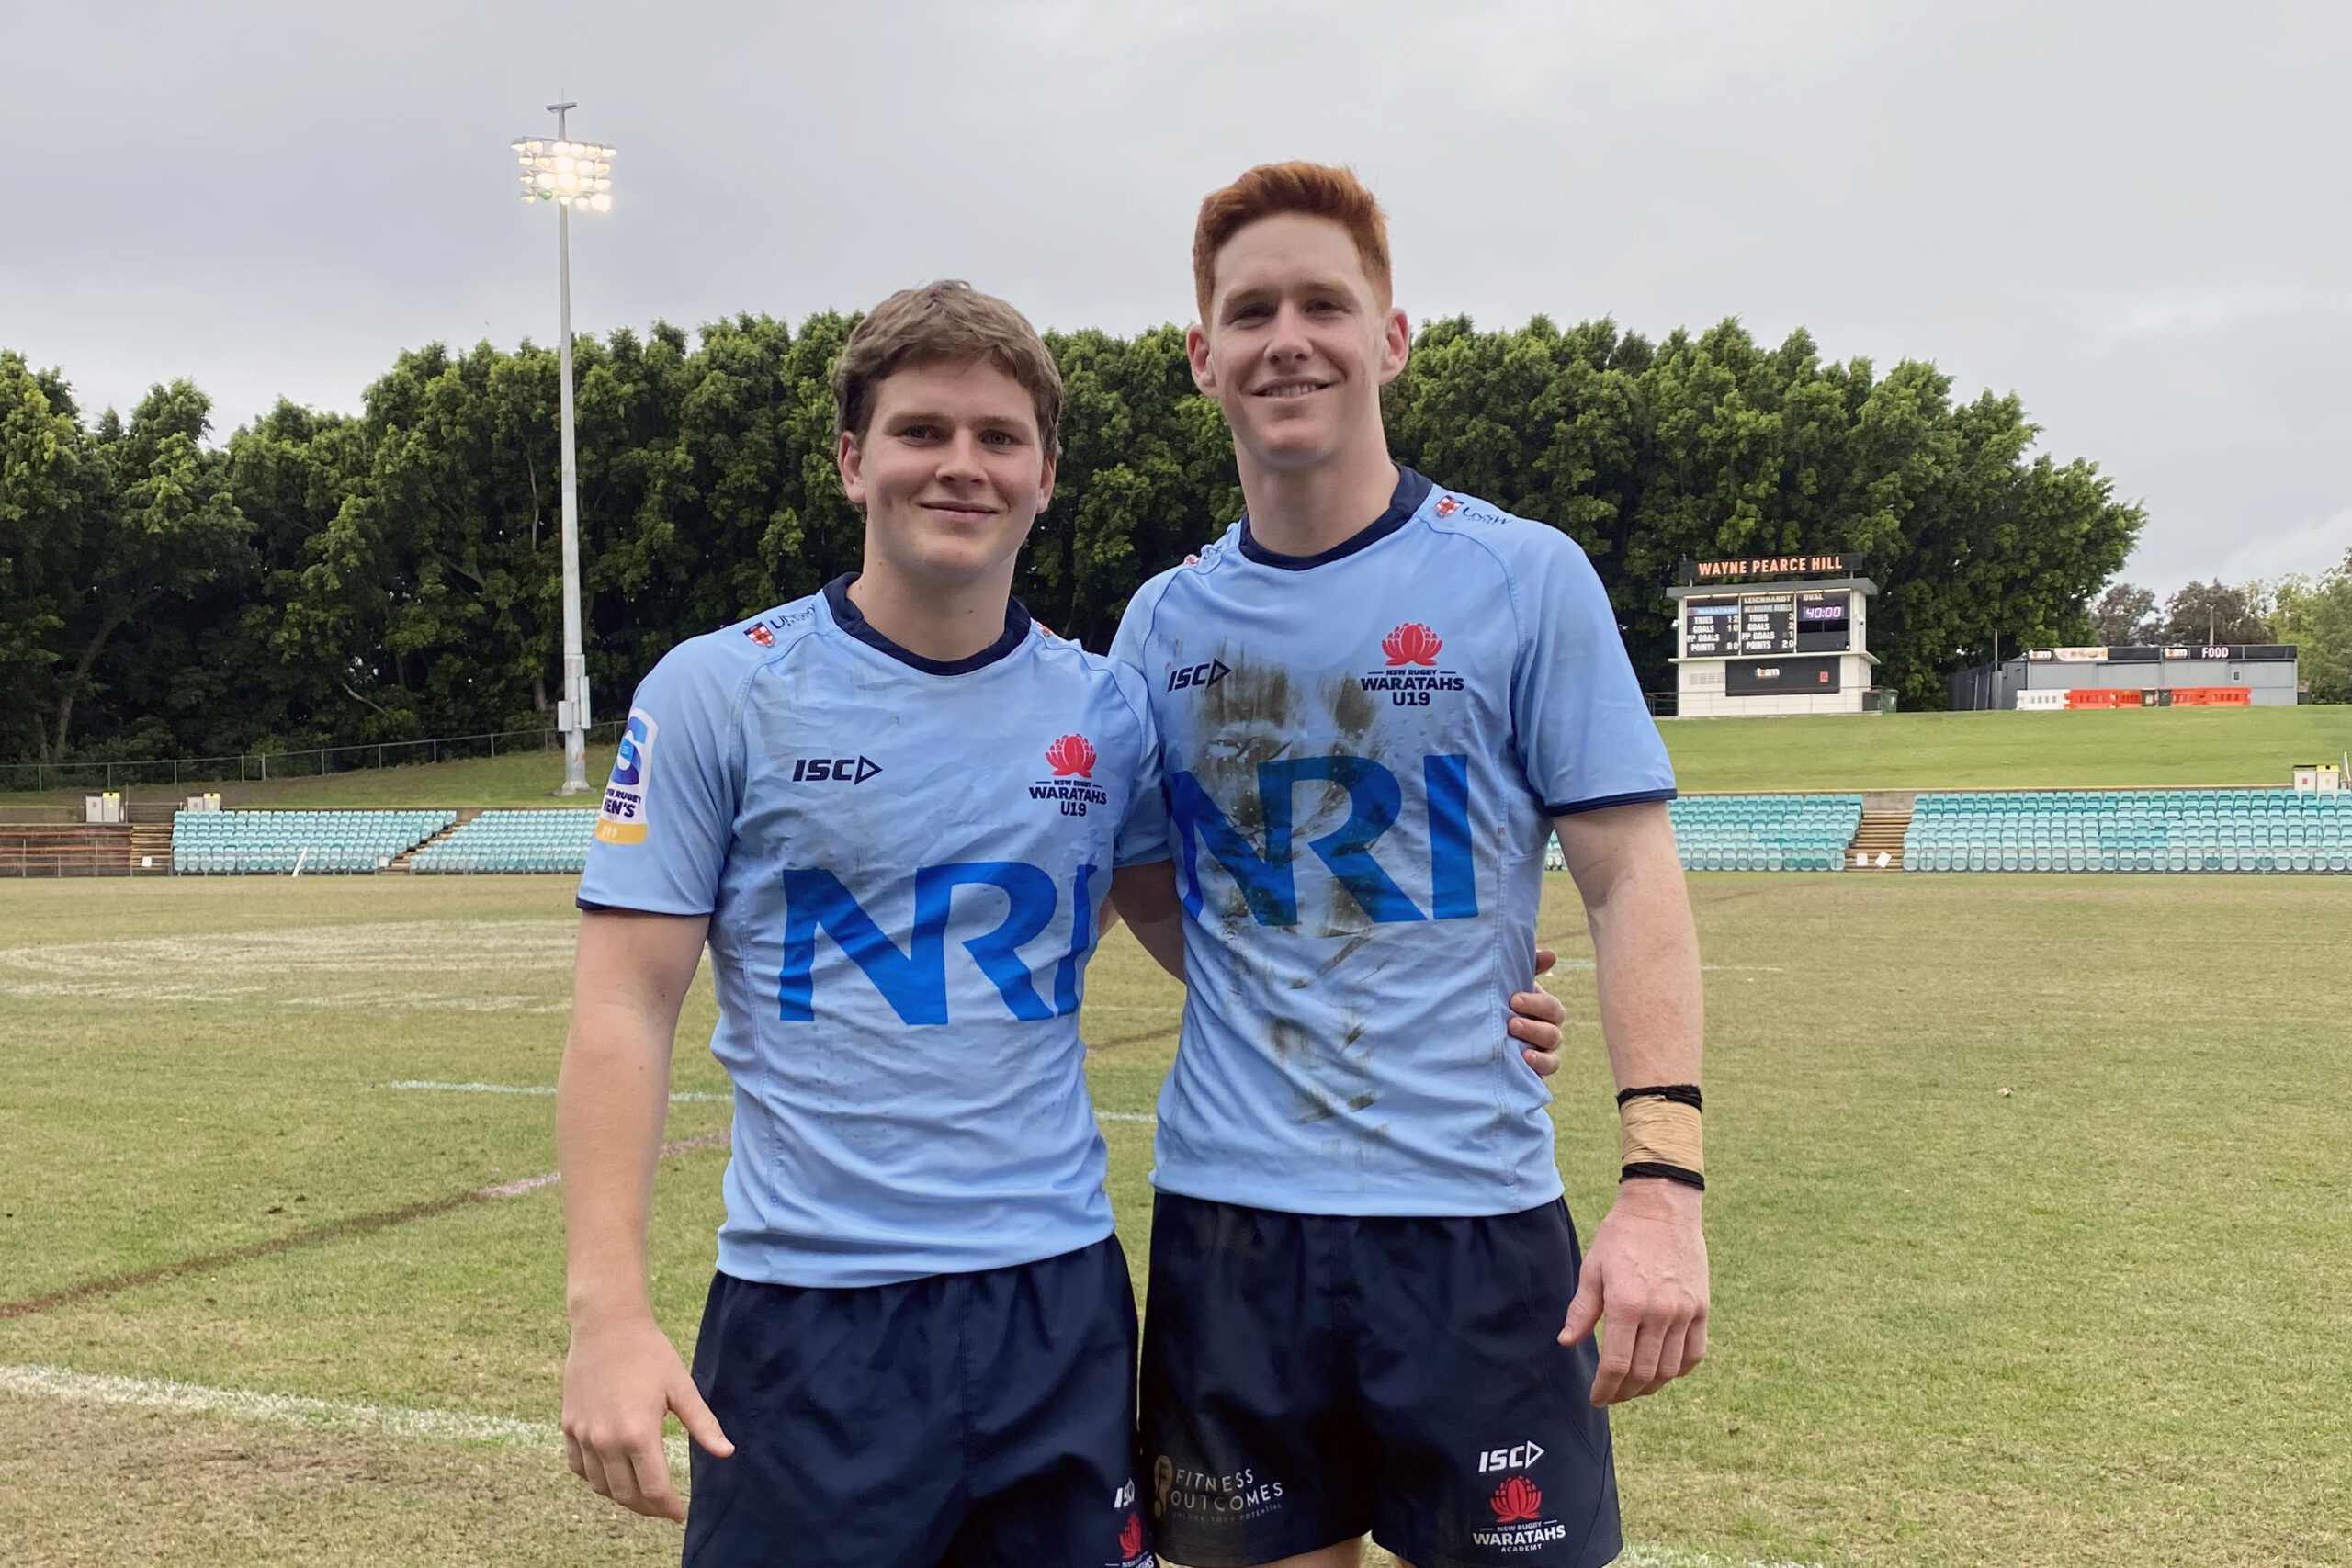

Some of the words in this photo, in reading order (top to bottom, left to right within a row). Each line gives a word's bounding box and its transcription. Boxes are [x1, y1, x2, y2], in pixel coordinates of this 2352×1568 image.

[1699, 561, 1747, 576] WAYNE
[1752, 558, 1806, 573] PEARCE
[1812, 556, 1842, 570] HILL
[1748, 614, 1770, 623] TRIES
[1788, 613, 1794, 621] 3
[1806, 606, 1842, 618] 40:00
[1694, 615, 1714, 625] TRIES
[1747, 623, 1770, 631] GOALS
[1788, 621, 1794, 630] 2
[1692, 625, 1715, 634] GOALS
[1752, 631, 1775, 640] GOALS
[1698, 633, 1720, 642] GOALS
[1746, 640, 1771, 649] POINTS
[1690, 643, 1716, 651] POINTS
[2201, 647, 2229, 658] FOOD
[1167, 661, 1210, 692] ISC
[1361, 677, 1464, 691] WARATAHS
[1392, 692, 1430, 706] U19
[793, 756, 855, 783] ISC
[615, 790, 641, 805] RUGBY
[1028, 787, 1107, 806] WARATAHS
[1060, 801, 1087, 818] U19
[1171, 753, 1479, 927] NRI
[779, 861, 1098, 1026] NRI
[1478, 1445, 1525, 1473] ISC
[1175, 1468, 1254, 1493] FITNESS
[1170, 1482, 1283, 1512] OUTCOMES
[1517, 1521, 1543, 1531] RUGBY
[1472, 1524, 1566, 1546] WARATAHS
[1500, 1542, 1543, 1553] ACADEMY
